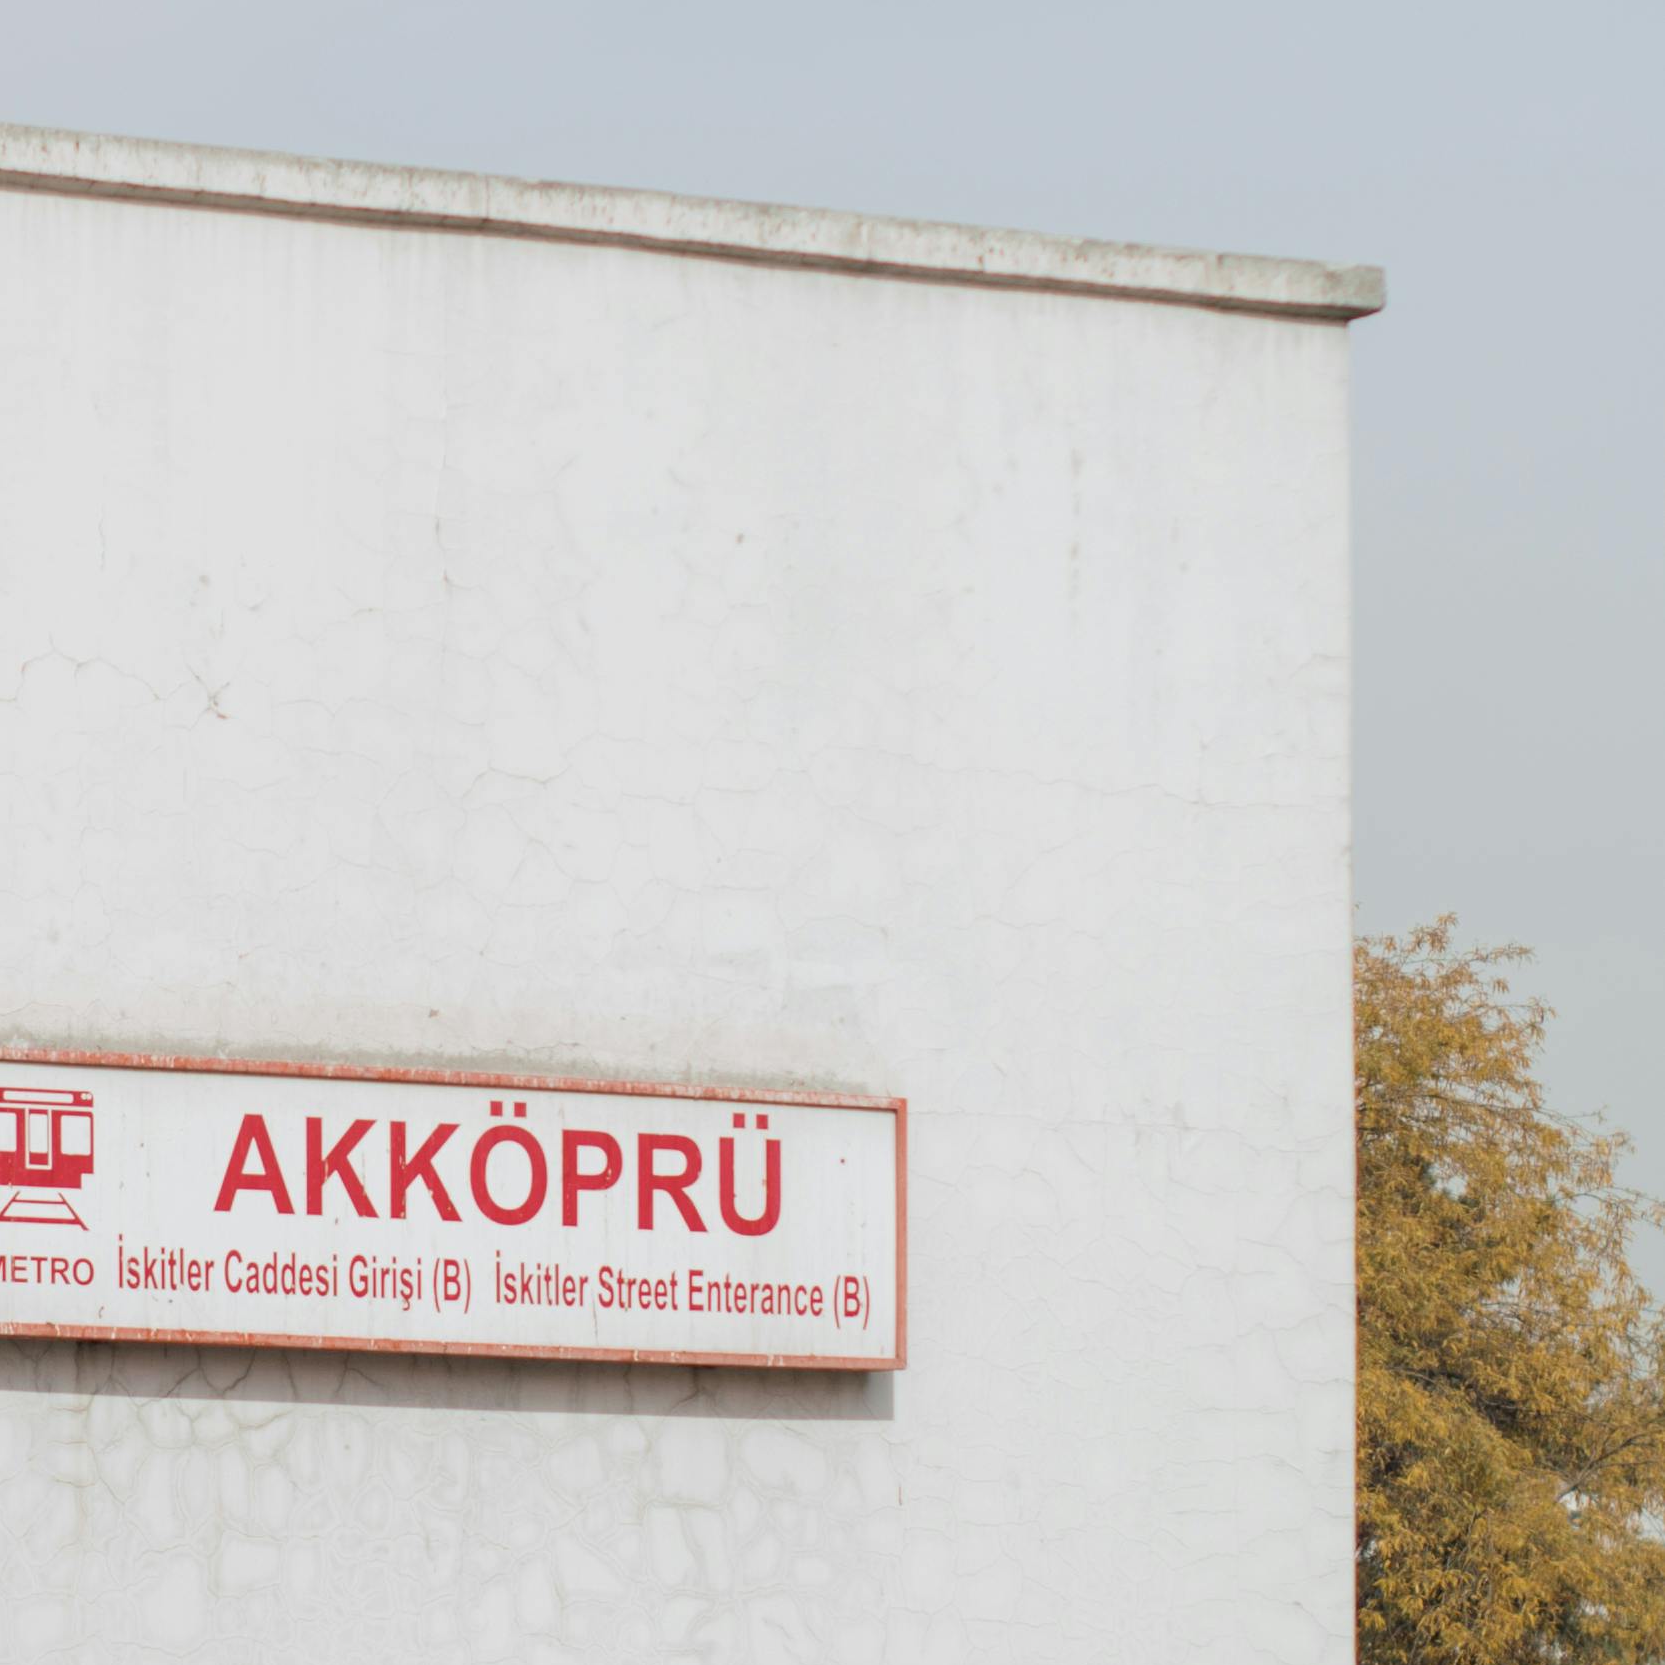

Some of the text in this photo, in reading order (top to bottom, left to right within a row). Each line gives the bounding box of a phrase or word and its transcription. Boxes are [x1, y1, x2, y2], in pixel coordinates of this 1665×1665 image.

[213, 1099, 782, 1238] AKKÖPRÜ
[117, 1234, 871, 1330] İskitler Caddesi Girişi (B) İskitler Street Enterance (B)
